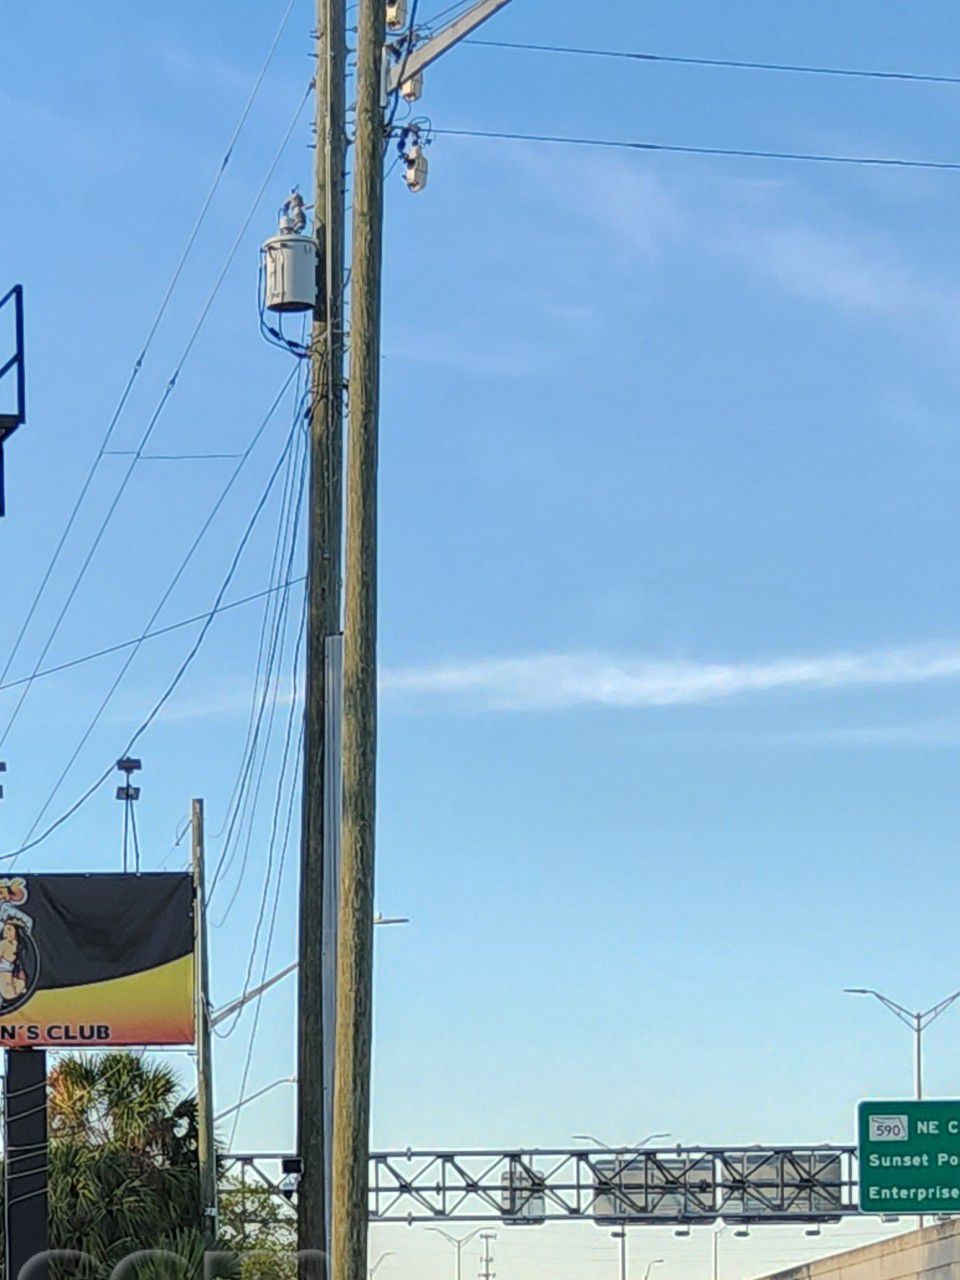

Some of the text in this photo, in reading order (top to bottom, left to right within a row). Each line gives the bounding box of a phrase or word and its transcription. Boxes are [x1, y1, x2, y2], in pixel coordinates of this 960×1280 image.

[46, 1024, 111, 1041] CLUB
[876, 1124, 901, 1136] 590
[917, 1121, 939, 1134] NE
[869, 1153, 929, 1167] Sunset
[869, 1185, 960, 1202] Enterprise
